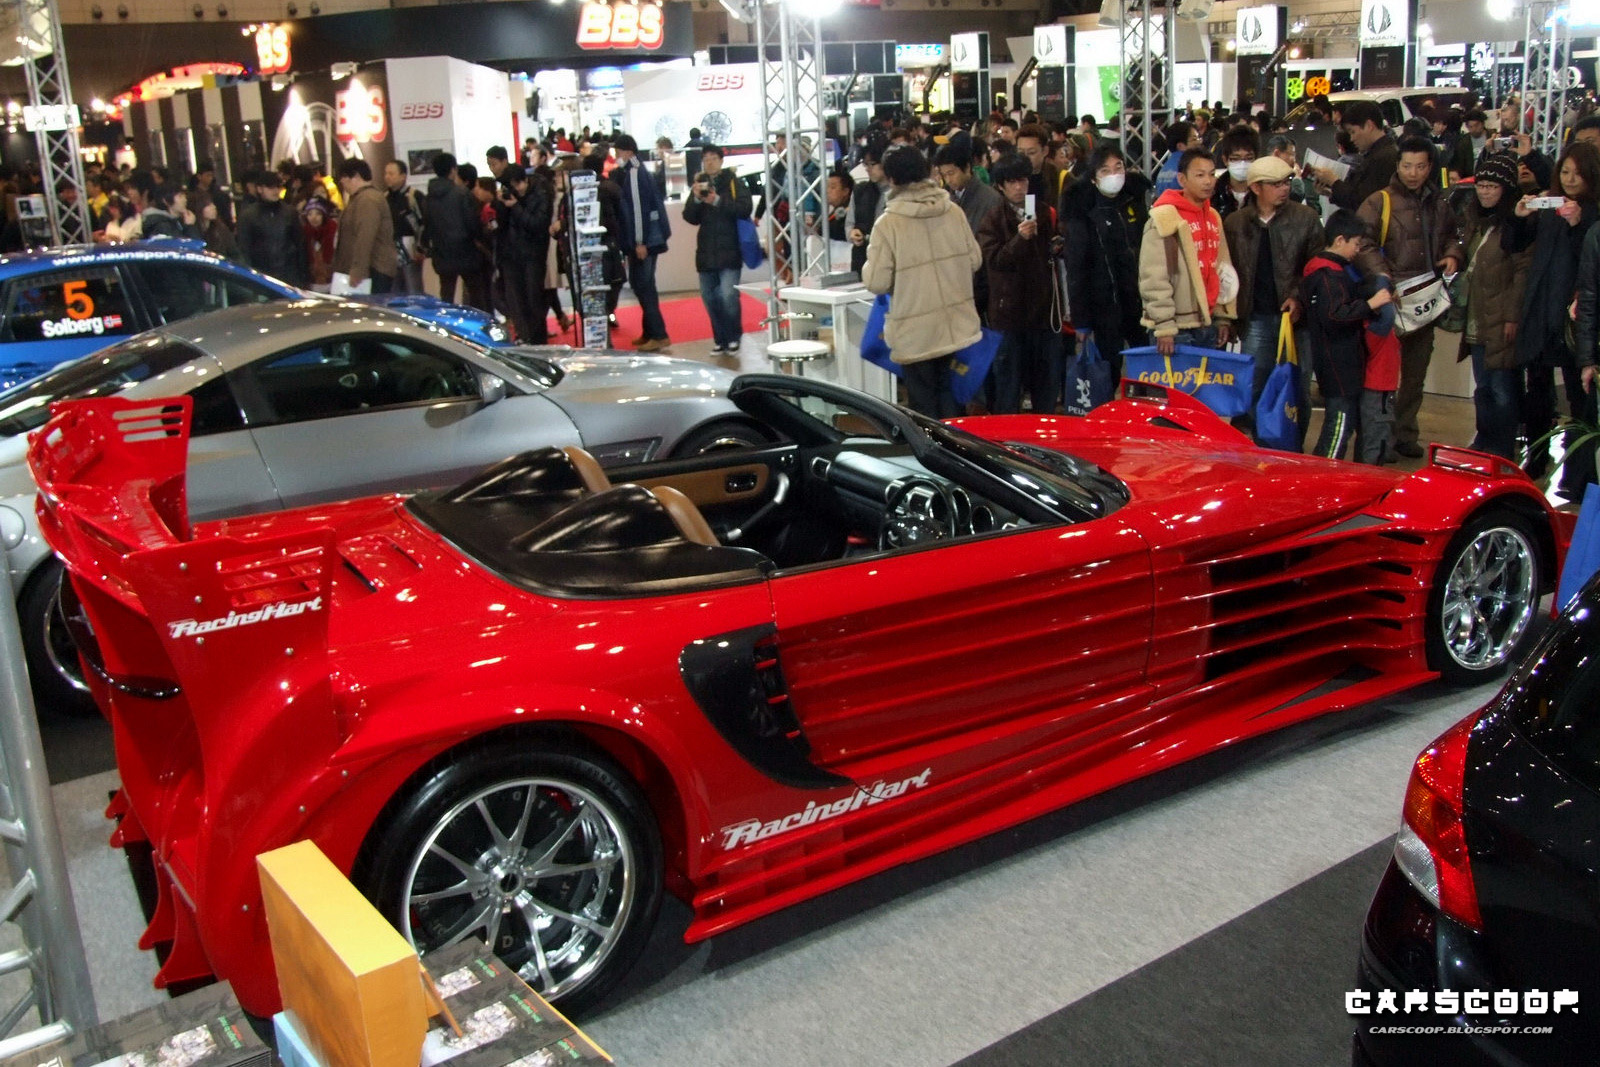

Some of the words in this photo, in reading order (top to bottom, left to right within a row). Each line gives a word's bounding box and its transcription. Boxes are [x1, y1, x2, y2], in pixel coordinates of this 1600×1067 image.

[576, 2, 665, 50] BBS
[697, 73, 744, 91] BBS
[335, 84, 388, 143] BS
[401, 102, 443, 119] BBS
[62, 280, 95, 319] 5
[41, 316, 105, 338] Solberg
[168, 596, 323, 639] RacingHart
[721, 767, 932, 850] RacingHart
